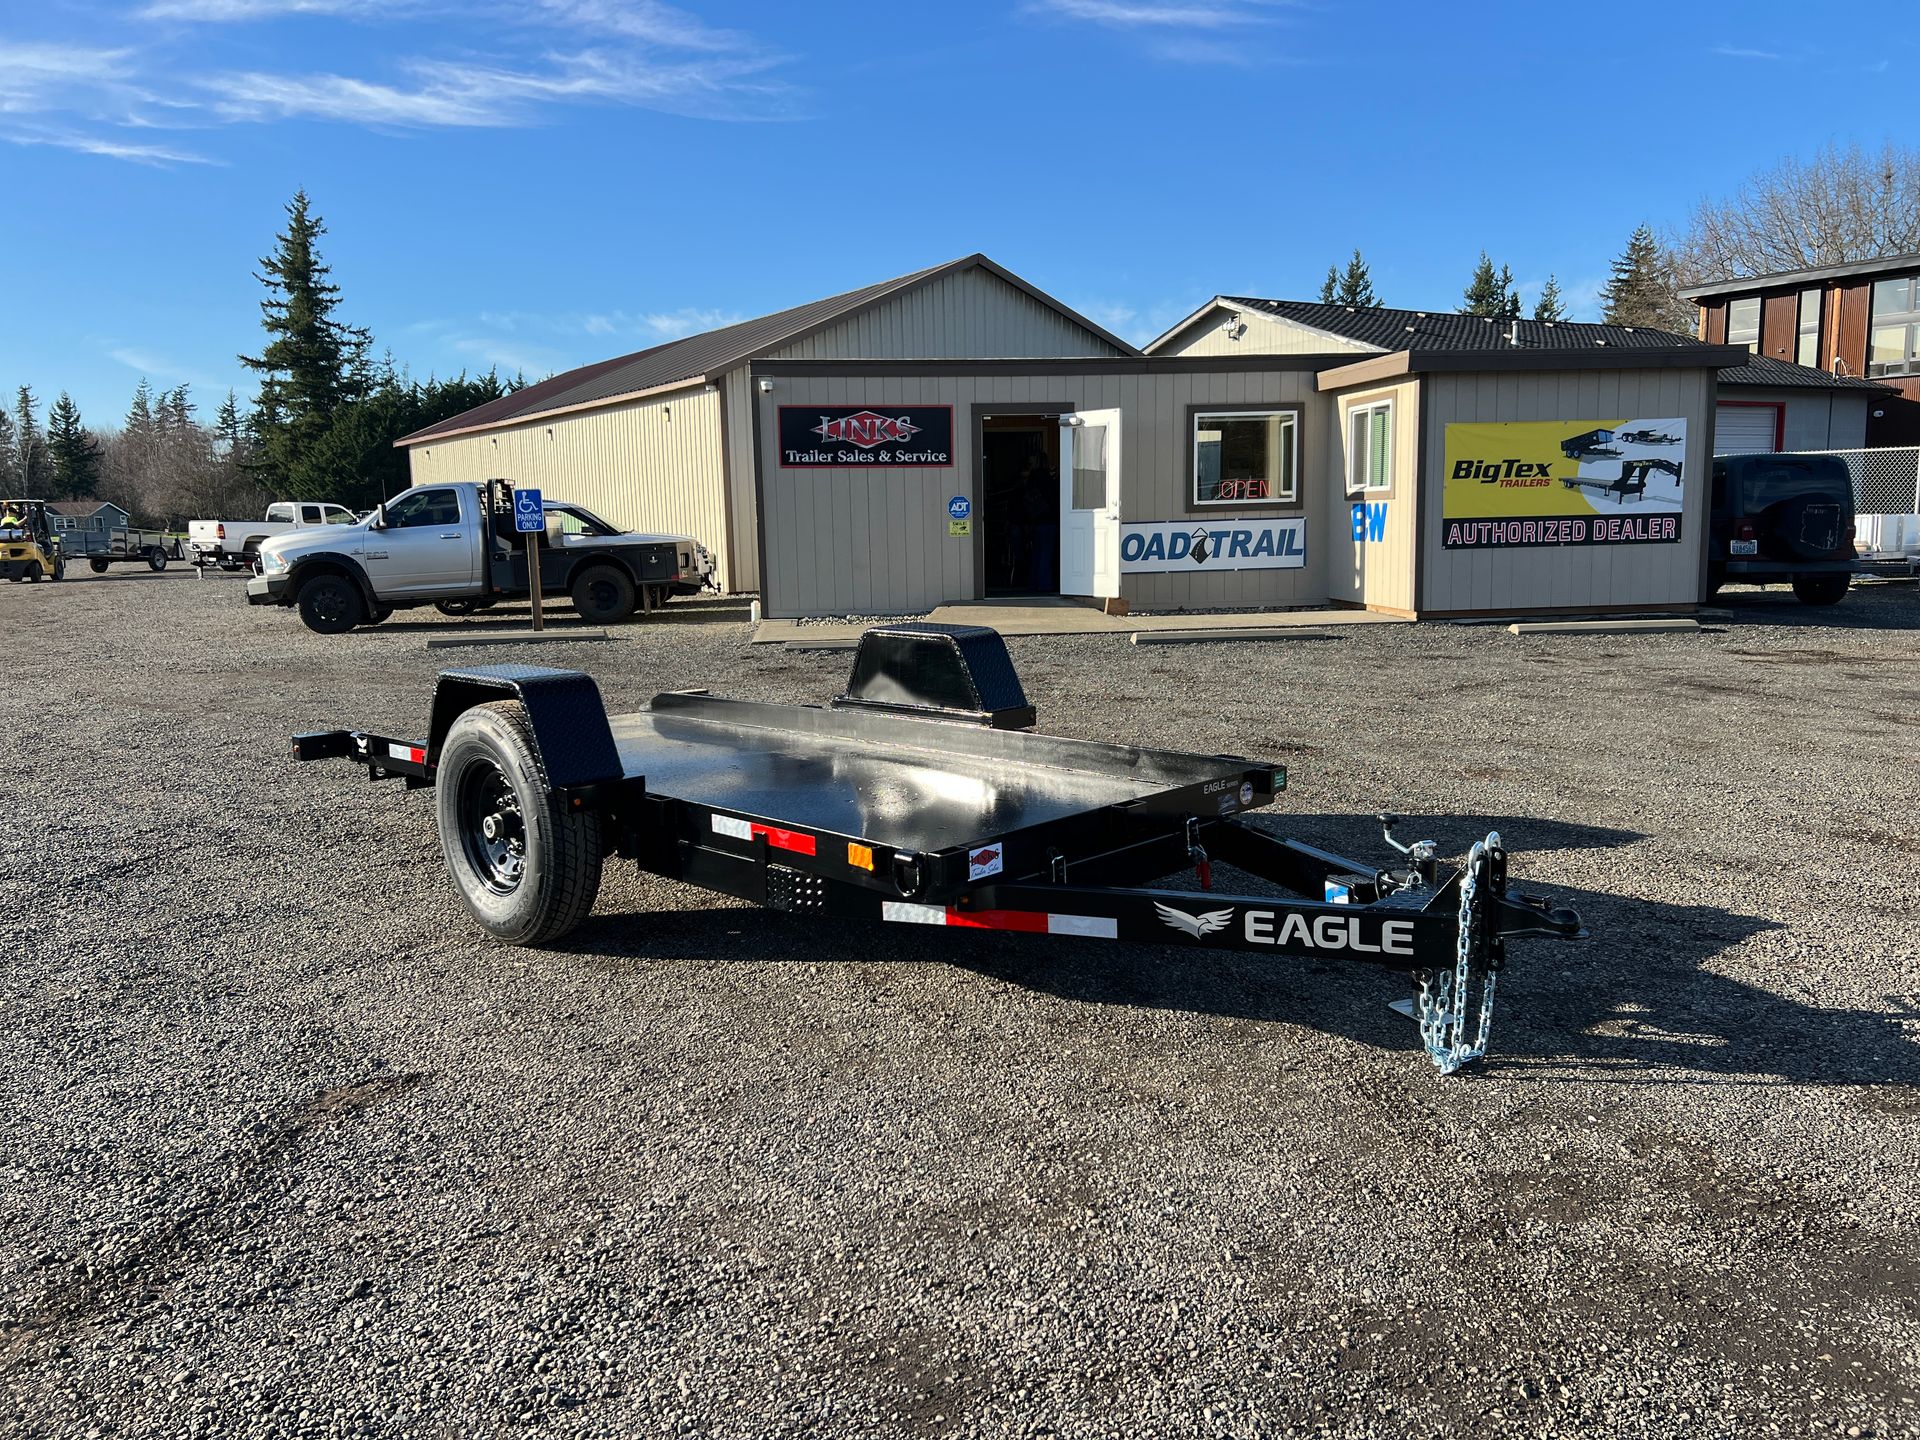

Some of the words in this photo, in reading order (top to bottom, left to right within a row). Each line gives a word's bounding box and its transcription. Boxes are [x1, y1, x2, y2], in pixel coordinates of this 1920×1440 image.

[820, 415, 912, 443] LINKS
[786, 450, 833, 462] Trailer
[838, 450, 874, 462] Sales
[879, 450, 891, 462] &
[896, 450, 947, 462] Service
[1220, 480, 1271, 498] OPEN
[1499, 479, 1551, 488] TRAILERS
[951, 502, 968, 511] ADT
[517, 513, 541, 521] PARKING
[522, 521, 537, 529] ONLY
[1448, 521, 1586, 544] AUTHORIZED
[1593, 518, 1676, 540] DEALER
[1121, 532, 1191, 562] OAD
[1210, 529, 1304, 558] TRAIL
[1203, 780, 1226, 794] EAGLE
[1244, 910, 1414, 955] EAGLE
